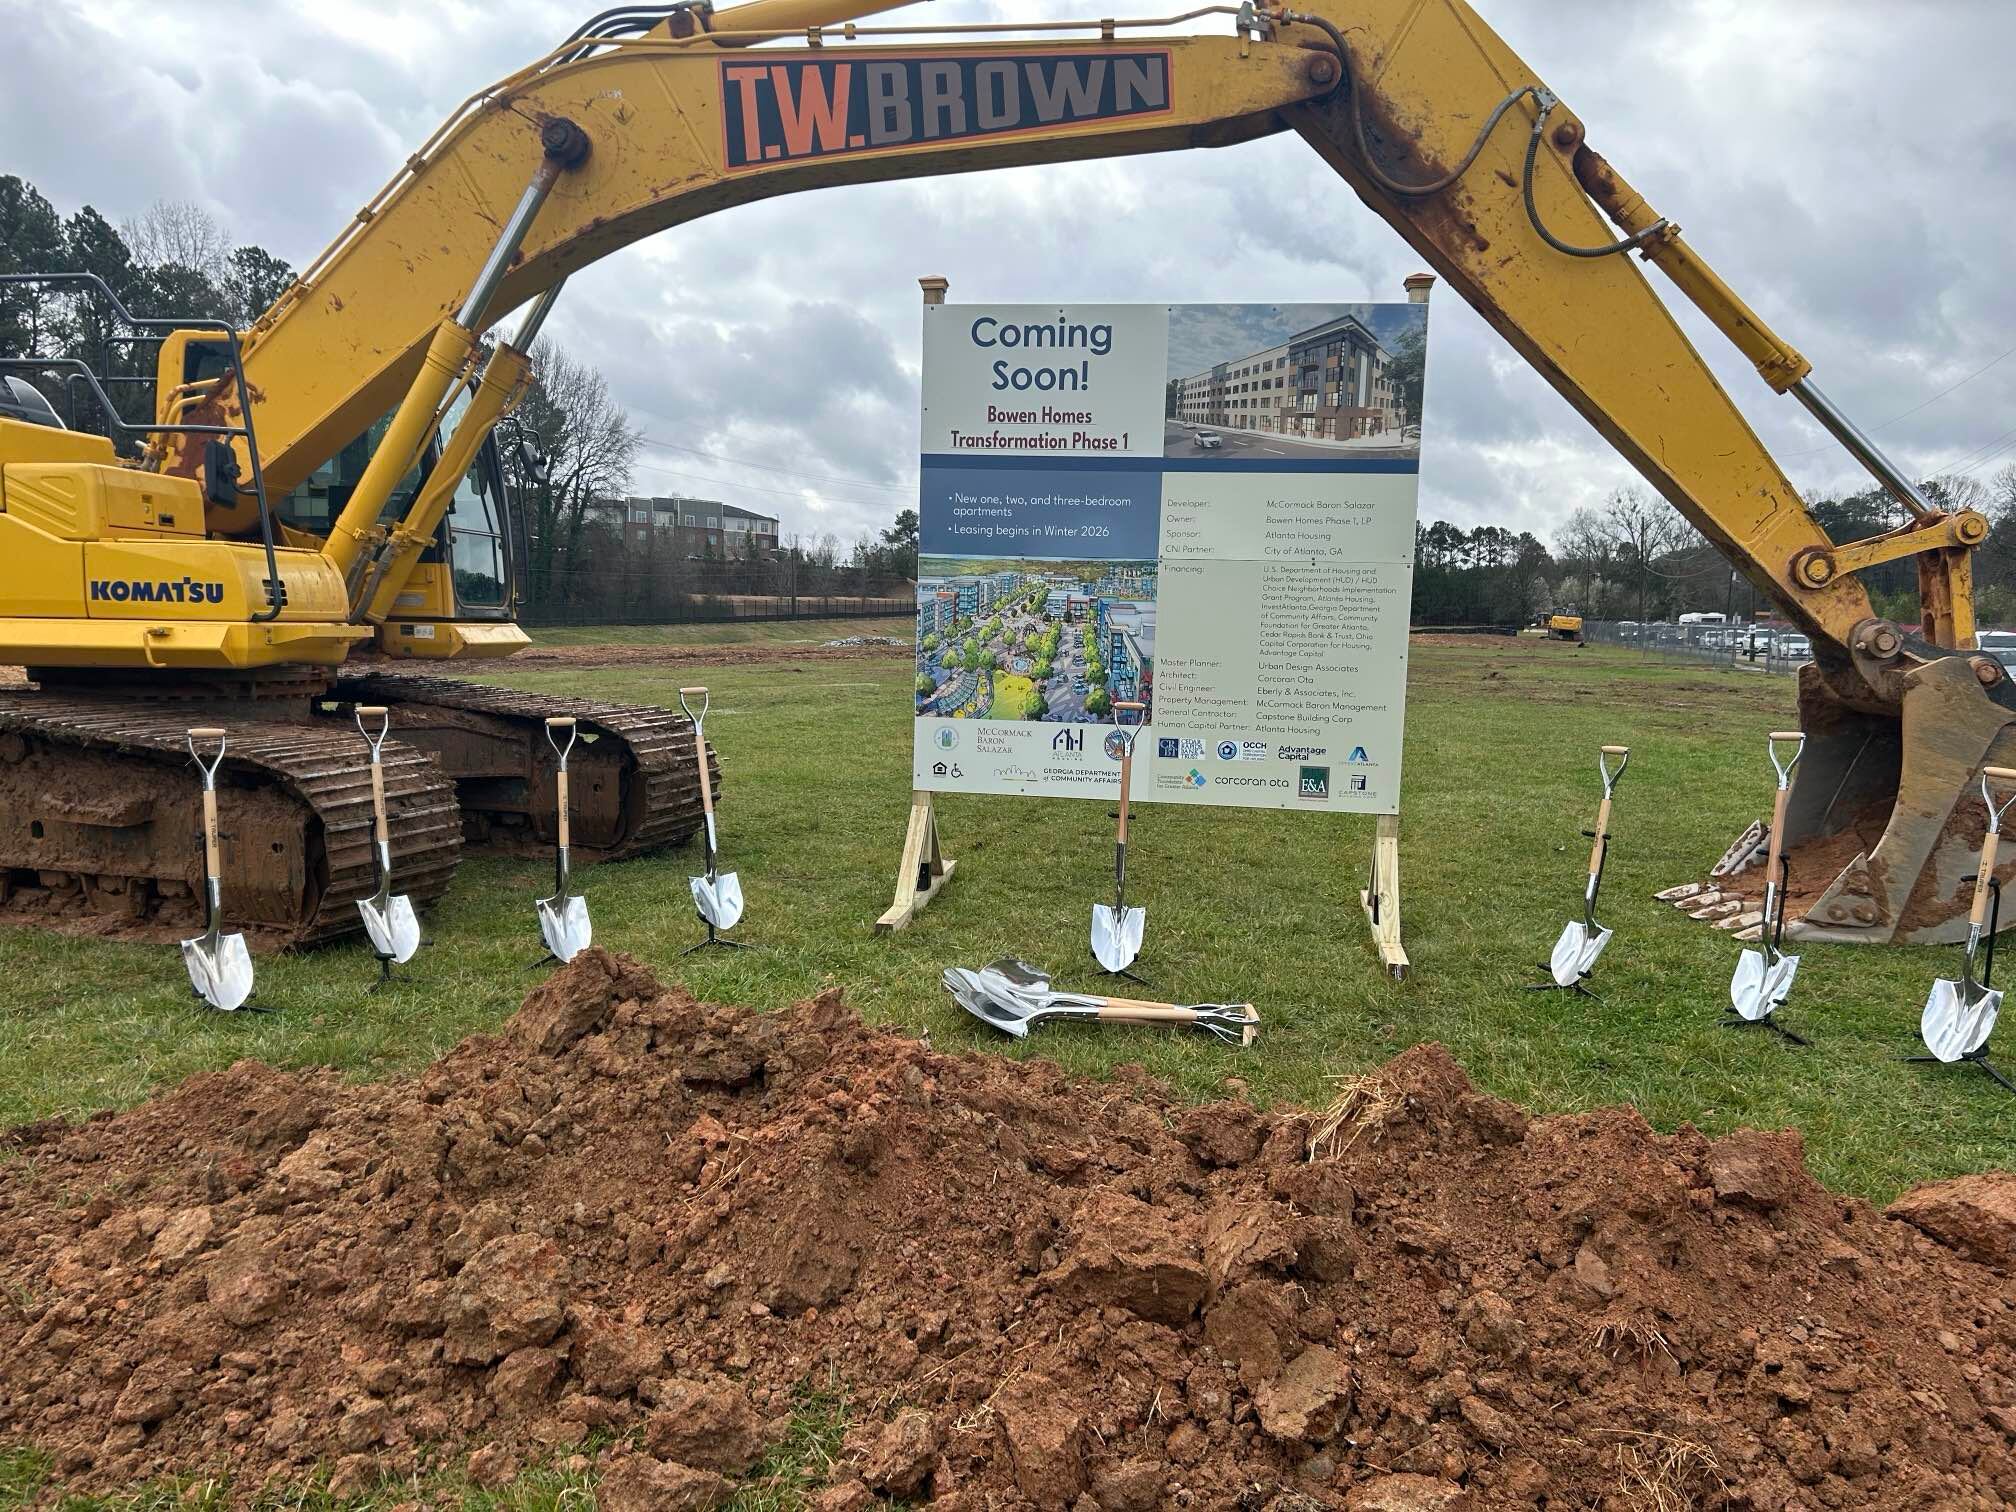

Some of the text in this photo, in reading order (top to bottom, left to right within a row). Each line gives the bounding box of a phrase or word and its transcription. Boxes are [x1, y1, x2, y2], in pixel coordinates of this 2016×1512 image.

[971, 316, 1112, 356] Coming
[992, 361, 1088, 391] Soon!
[987, 405, 1092, 424] Bowen Homes
[951, 430, 1129, 450] Transformation Phase 1
[955, 493, 1131, 507] New one, two, and three-bedroom
[1167, 499, 1210, 509] Developer:
[1266, 500, 1376, 510] McCormack Baron Salazar
[953, 506, 1013, 518] apartments
[1166, 514, 1195, 523] Owner:
[1266, 516, 1293, 524] Bowen
[1295, 516, 1324, 525] Homes
[1326, 517, 1351, 525] Phase
[1361, 517, 1372, 526] LP
[954, 523, 1110, 538] Leasing begins in Winter 2026
[1166, 529, 1200, 539] Sponsor:
[1265, 531, 1332, 541] Atlanta Housing
[1182, 545, 1215, 553] Partner:
[1264, 546, 1343, 556] City of Atlanta, GA
[1286, 576, 1331, 584] Development
[91, 576, 224, 603] KOMATSU
[1342, 586, 1397, 594] Implementation
[1270, 613, 1309, 621] Community
[1338, 614, 1378, 622] Community
[1259, 640, 1285, 648] Capital
[1286, 640, 1328, 649] Corporation
[1330, 641, 1340, 649] for
[1259, 649, 1324, 658] Advantage Capital
[1160, 658, 1221, 668] Master Planner:
[1258, 662, 1359, 673] Urban Design Associates
[1160, 671, 1197, 679] Architect:
[1257, 674, 1314, 684] Corcoran Ota
[1160, 683, 1177, 691] Civil
[1257, 687, 1357, 698] Eberly & Associates, Inc.
[1159, 696, 1248, 707] Property Management:
[1256, 700, 1387, 712] McCormack Baron Management
[1158, 707, 1237, 718] General Contractor:
[1256, 712, 1353, 724] Capstone Building Corp
[1188, 720, 1217, 730] Capital
[1256, 724, 1321, 736] Atlanta Housing
[977, 736, 1005, 745] BARON
[1243, 741, 1267, 750] OCCH
[976, 744, 1013, 754] SALAZAR
[1278, 745, 1327, 755] Advantage
[1278, 752, 1309, 761] Capital
[1075, 769, 1121, 777] DEPARTMENT
[1051, 775, 1093, 783] COMMUNITY
[1214, 776, 1289, 788] corcoran ota
[1301, 778, 1326, 793] E&A
